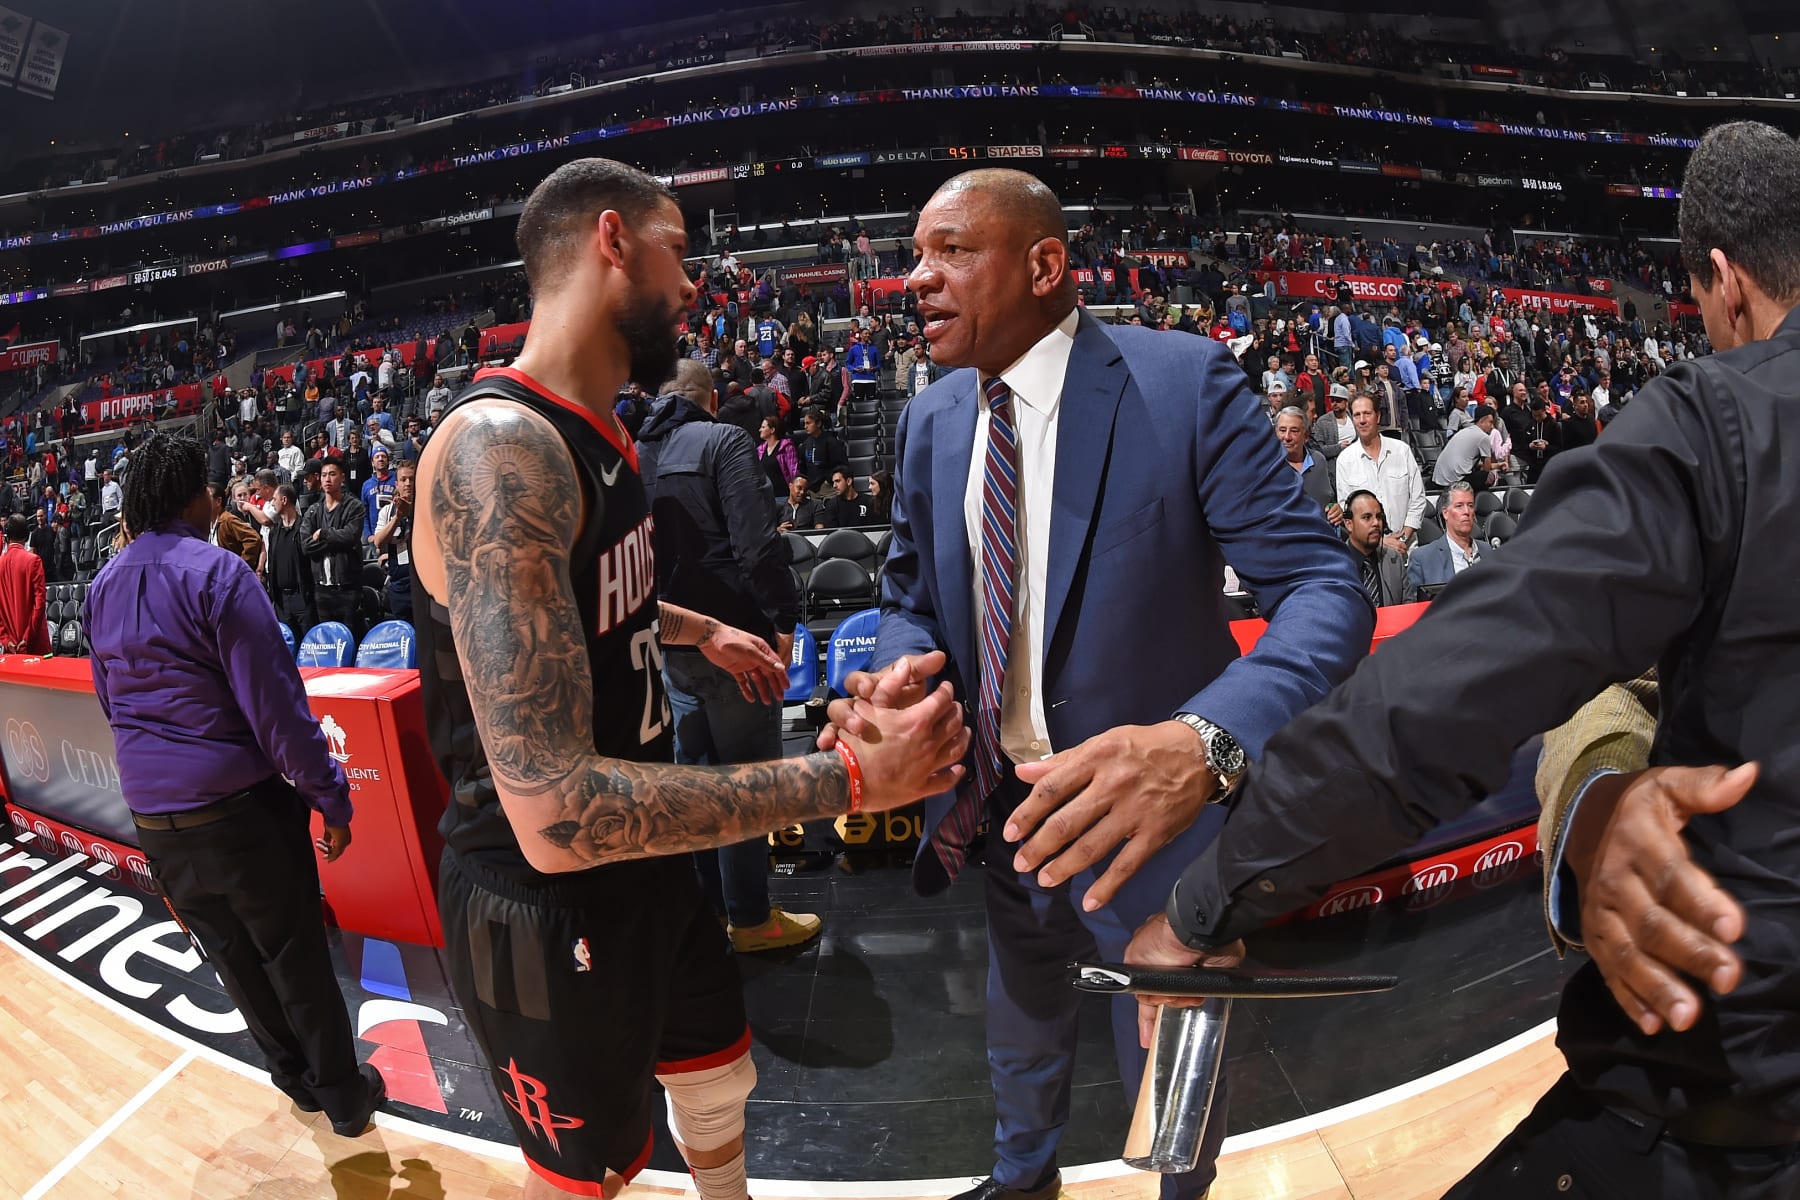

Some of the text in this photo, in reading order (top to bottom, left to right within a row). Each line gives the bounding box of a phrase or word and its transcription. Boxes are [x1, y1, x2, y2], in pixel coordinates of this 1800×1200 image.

[678, 55, 714, 66] DELTA
[902, 88, 954, 100] THANK
[1002, 86, 1039, 96] FANS
[1136, 88, 1184, 100] THANK
[1224, 94, 1256, 106] FANS
[664, 110, 713, 126] THANK
[760, 100, 798, 112] FANS
[1334, 106, 1374, 119] THANK
[1406, 114, 1432, 126] FANS
[1500, 124, 1534, 136] THANK
[1563, 130, 1587, 142] FANS
[1648, 136, 1679, 146] THANK
[454, 150, 495, 168] THANK
[537, 136, 570, 151] FANS
[889, 151, 927, 161] DELTA
[989, 146, 1041, 157] STAPLES
[1156, 146, 1171, 154] HOU
[822, 156, 861, 166] BUD LIGHT
[1228, 152, 1273, 164] TOYOTA
[734, 164, 750, 172] HOU
[676, 168, 728, 184] TOSHIBA
[1478, 176, 1512, 186] Spectrum
[268, 188, 306, 204] THANK
[342, 177, 372, 190] FANS
[100, 221, 134, 235] THANK
[166, 210, 193, 223] FANS
[448, 208, 489, 226] Spectrum
[7, 236, 32, 248] FANS
[188, 258, 228, 274] TOYOTA
[798, 270, 823, 278] MANUEL
[824, 268, 846, 276] CASINO
[760, 330, 772, 340] 23
[112, 394, 154, 420] CLIPPERS
[312, 642, 336, 650] NATIONAL
[370, 642, 400, 650] NATIONAL
[834, 636, 877, 646] CITY NAT
[37, 824, 52, 838] KIA
[64, 836, 82, 851] KIA
[96, 847, 115, 864] KIA
[1482, 848, 1514, 870] KIA
[1413, 870, 1448, 891] KIA
[1331, 891, 1371, 916] KIA
[458, 1108, 483, 1122] TM
